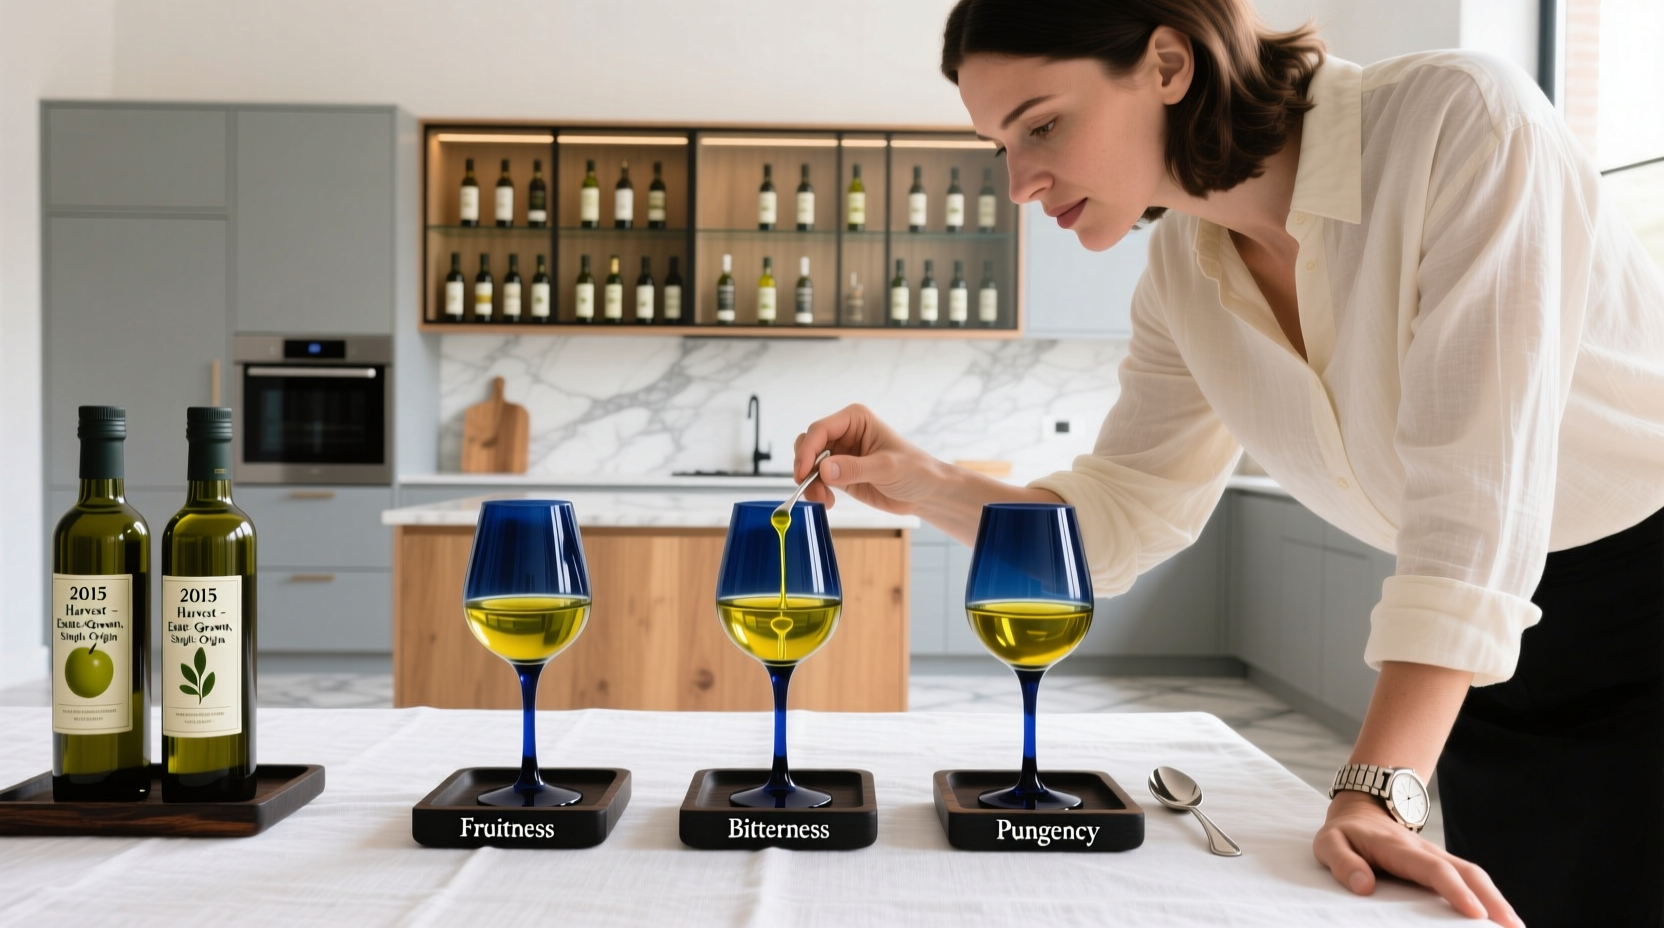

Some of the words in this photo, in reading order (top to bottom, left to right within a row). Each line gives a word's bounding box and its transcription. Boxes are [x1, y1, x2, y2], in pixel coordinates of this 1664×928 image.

[70, 586, 107, 601] 2015
[180, 588, 217, 603] 2015
[459, 816, 556, 840] Fruitness
[728, 817, 831, 840] Bitterness
[995, 818, 1101, 848] Pungency
